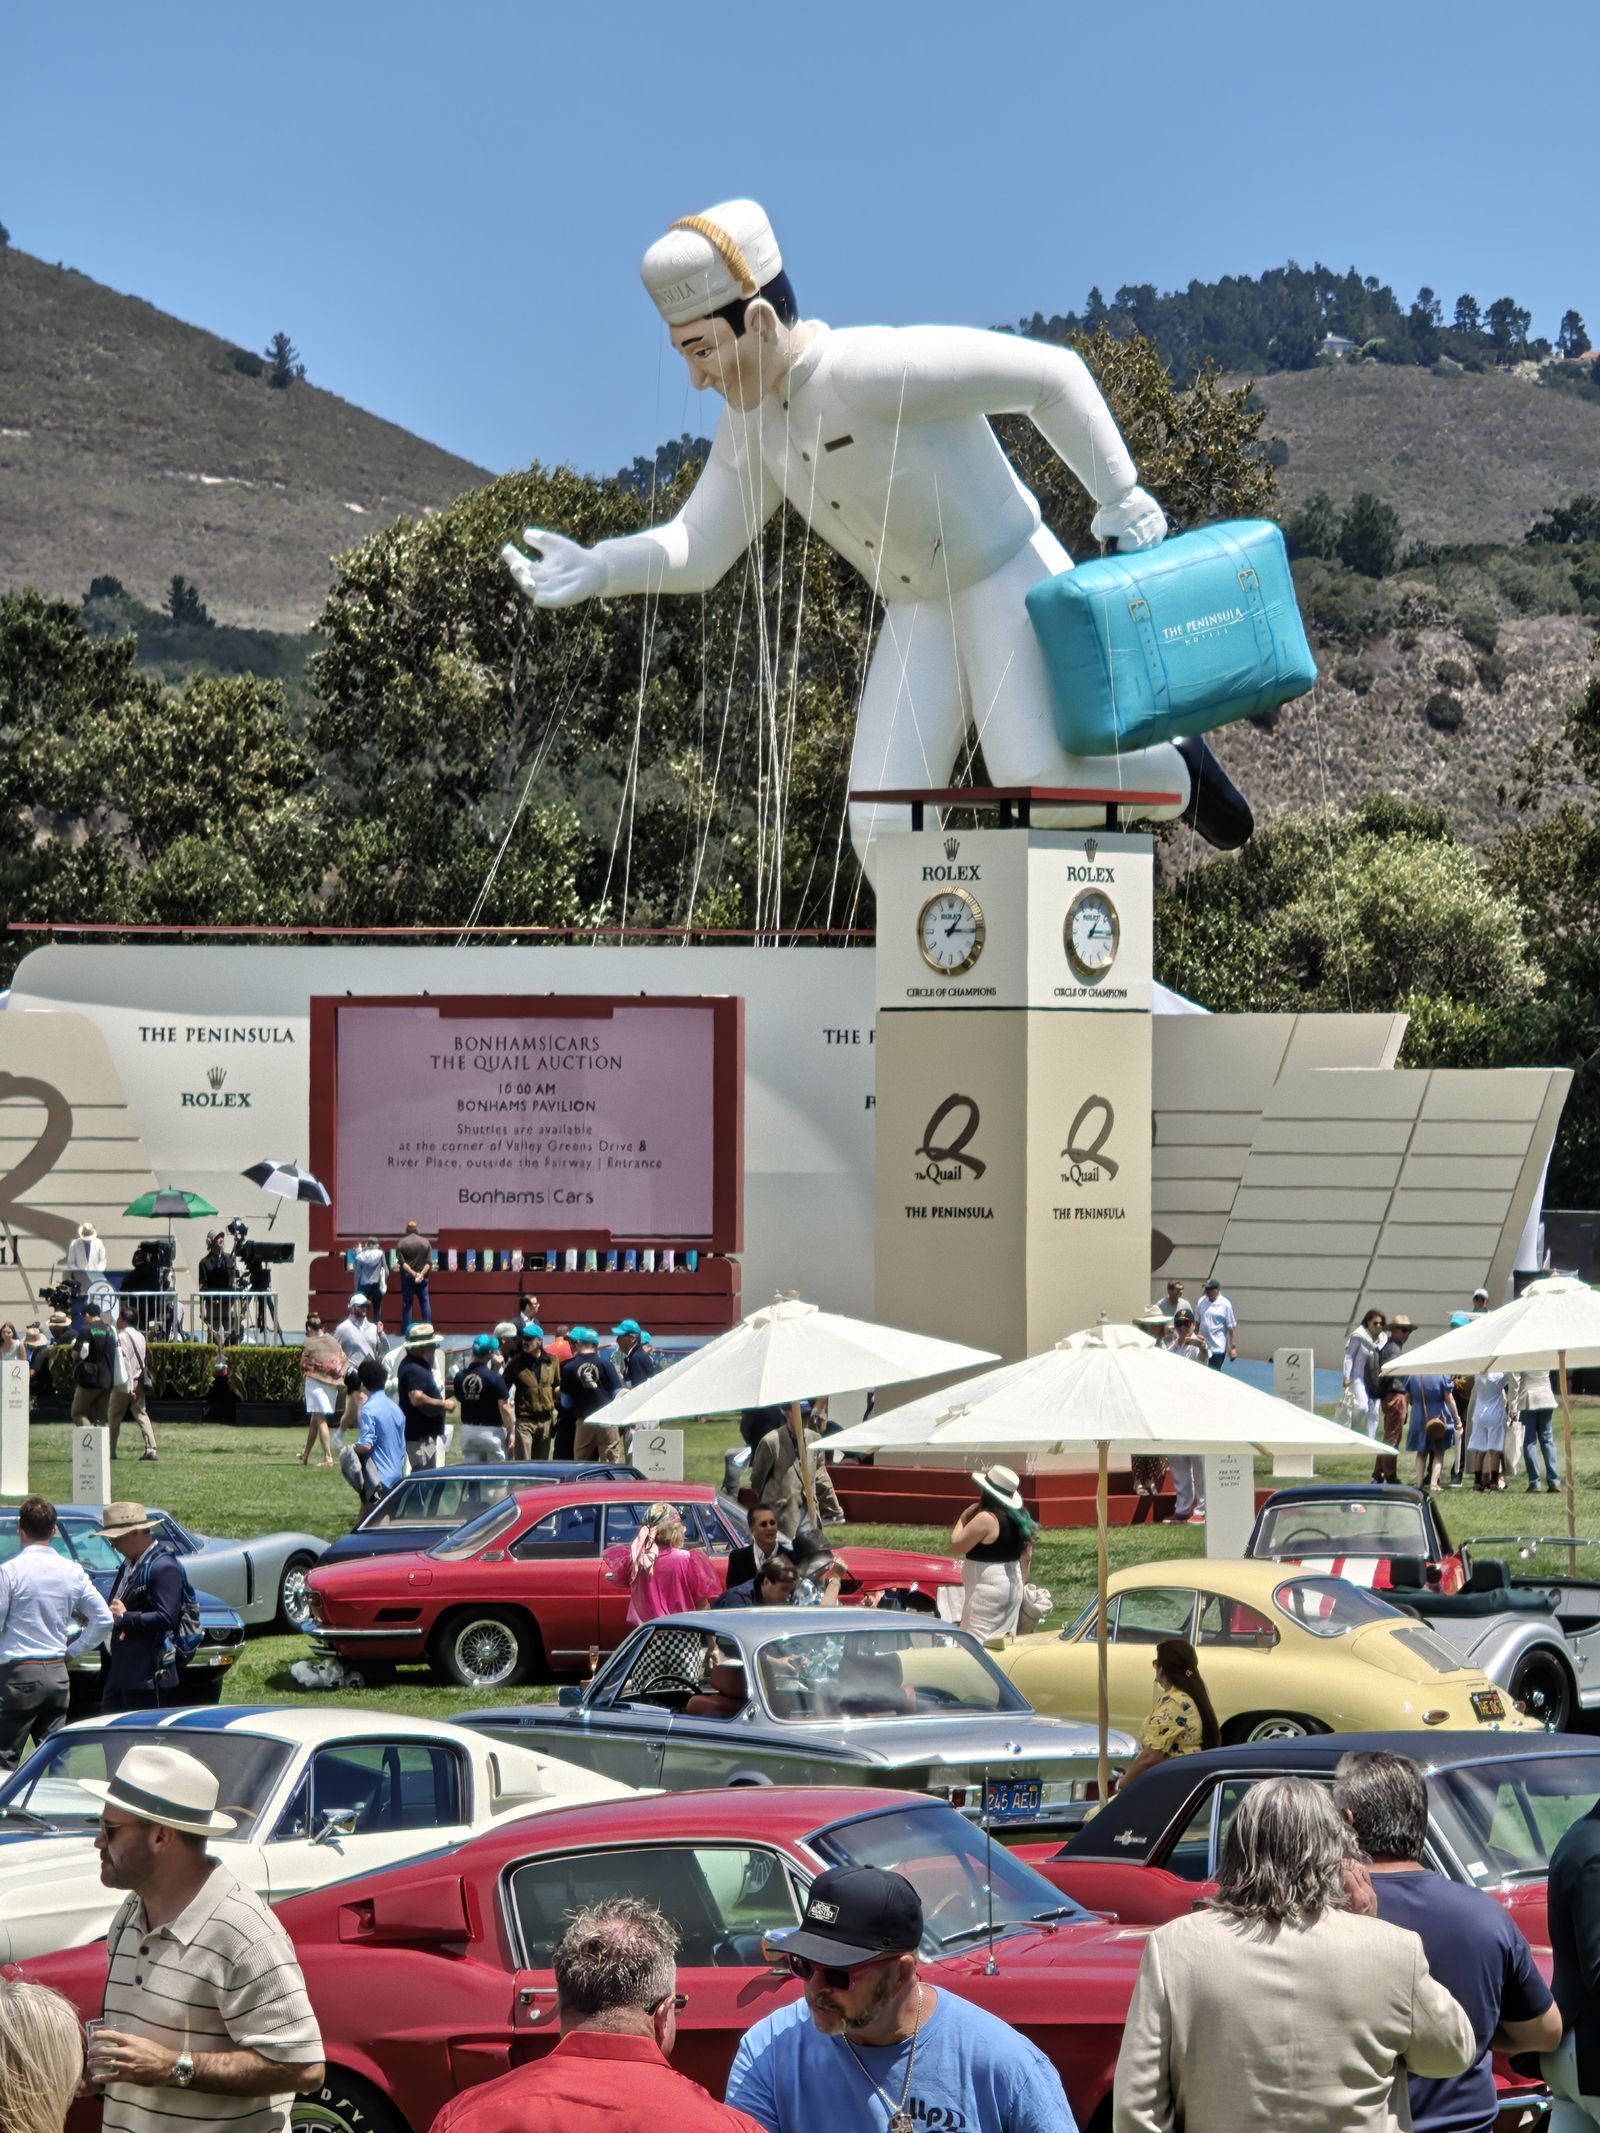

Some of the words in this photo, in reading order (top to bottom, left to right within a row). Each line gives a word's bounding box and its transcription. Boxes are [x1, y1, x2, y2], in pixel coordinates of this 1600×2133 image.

[1162, 624, 1183, 639] THE
[1186, 607, 1243, 633] PENINSULA
[922, 865, 981, 881] ROLEX
[1067, 866, 1115, 883] ROLEX
[906, 988, 935, 998] CIRCLE
[936, 988, 947, 997] OF
[947, 987, 996, 997] CHAMPIONS
[1054, 988, 1077, 998] CIRCLE
[1078, 988, 1087, 997] OF
[1088, 988, 1127, 999] CHAMPIONS
[139, 1027, 177, 1043] THE
[186, 1027, 295, 1043] PENINSULA
[823, 1029, 861, 1044] THE
[431, 1055, 465, 1070] THE
[474, 1055, 530, 1072] QUAIL
[537, 1055, 622, 1070] AUCTION
[535, 1083, 556, 1095] AM
[181, 1093, 251, 1107] ROLEX
[457, 1100, 526, 1112] BONHAMS
[532, 1100, 595, 1112] PAVILION
[457, 1123, 507, 1135] Shuttles
[513, 1126, 533, 1135] are
[539, 1124, 592, 1135] available
[399, 1141, 410, 1151] at
[416, 1141, 436, 1151] the
[442, 1143, 483, 1151] corner
[490, 1140, 502, 1151] of
[506, 1140, 542, 1153] Valley
[547, 1140, 592, 1152] Greens
[599, 1140, 633, 1152] Drive
[387, 1156, 418, 1168] River
[466, 1157, 512, 1168] outside
[519, 1157, 539, 1168] the
[544, 1156, 592, 1170] Fairway
[607, 1156, 662, 1168] Entrance
[915, 1172, 926, 1180] The
[926, 1163, 961, 1185] Quail
[1070, 1164, 1099, 1186] Quail
[905, 1207, 927, 1218] THE
[931, 1207, 994, 1219] PENINSULA
[1053, 1208, 1072, 1219] THE
[1075, 1208, 1125, 1220] PENINSULA
